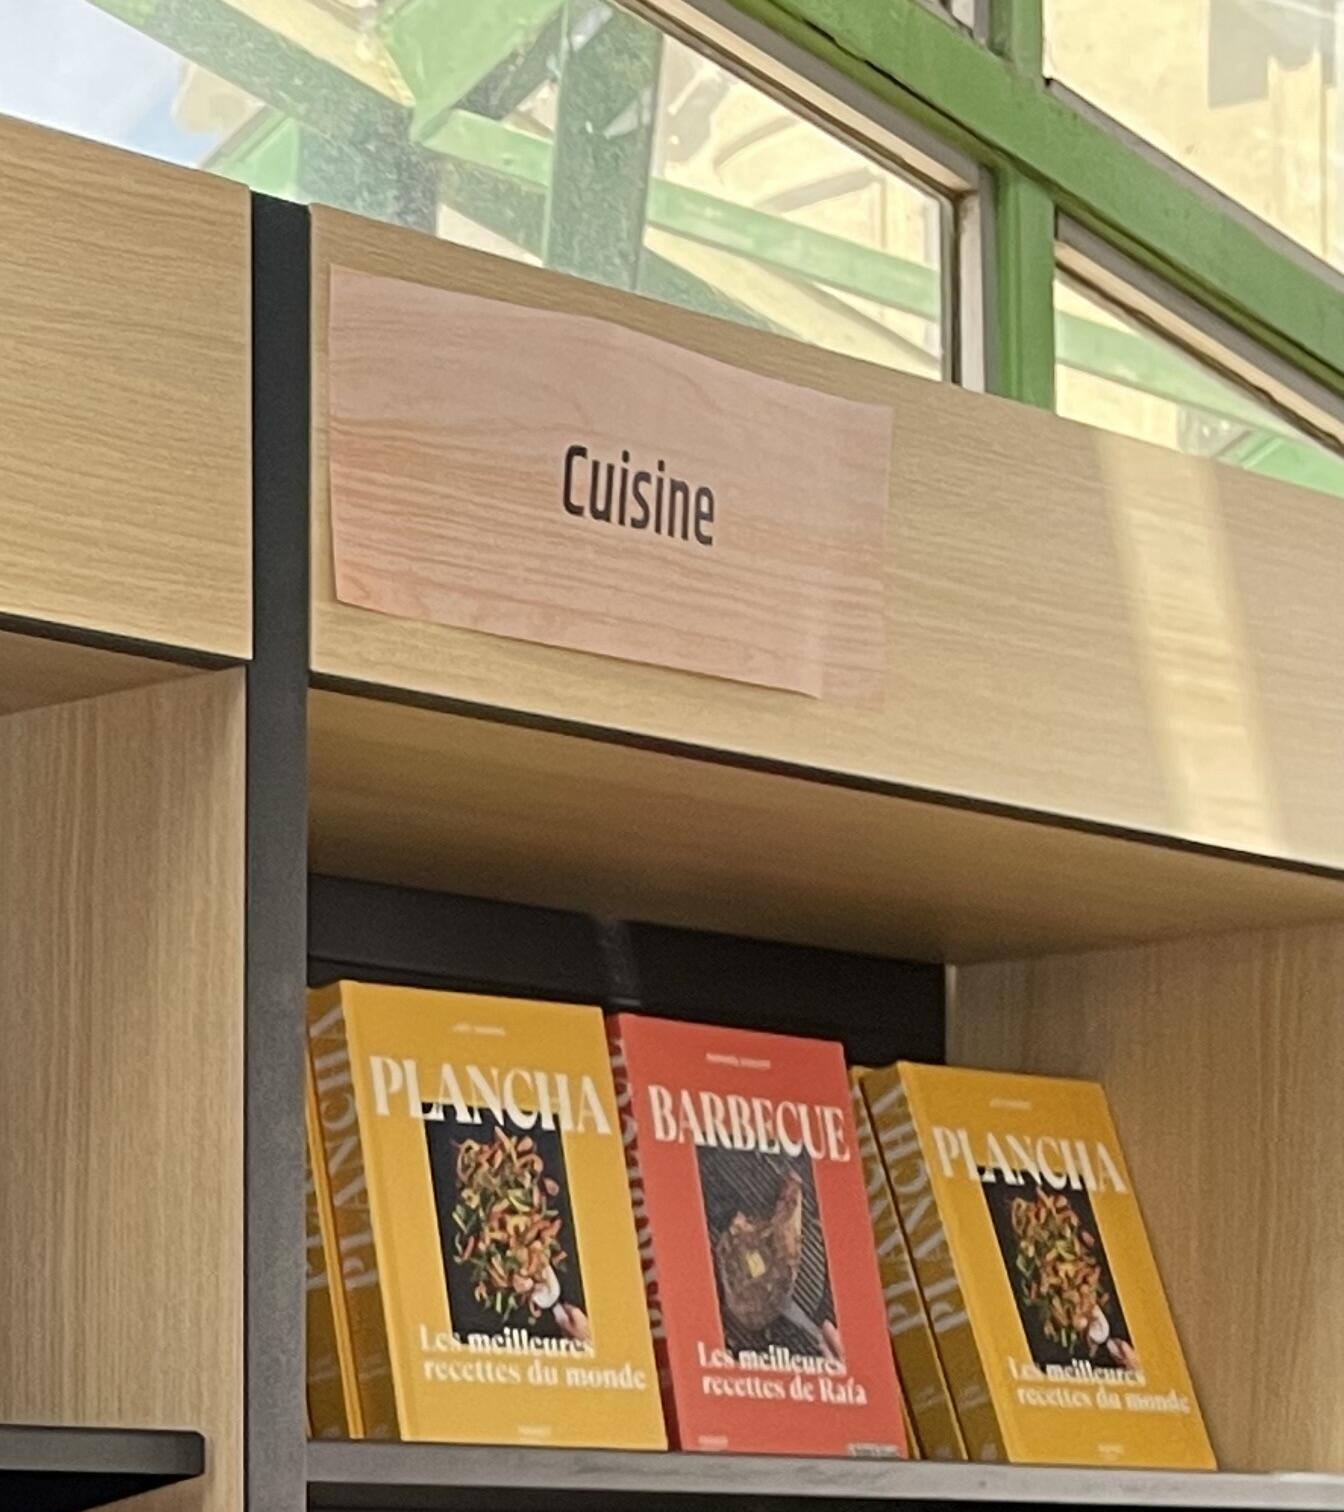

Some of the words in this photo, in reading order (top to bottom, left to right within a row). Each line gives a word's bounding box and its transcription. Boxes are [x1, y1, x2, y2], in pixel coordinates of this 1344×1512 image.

[563, 444, 715, 546] Cuisine
[368, 1054, 613, 1137] PLANCHA
[647, 1084, 851, 1163] BARBECUE
[309, 1004, 378, 1291] PLANCHA
[930, 1124, 1130, 1195] PLANCHA
[419, 1324, 463, 1351] Les
[467, 1327, 595, 1359] meilleures
[696, 1340, 735, 1369] Les
[738, 1344, 848, 1378] meilleures
[423, 1359, 521, 1384] recettes
[527, 1359, 559, 1386] du
[565, 1363, 646, 1391] monde
[702, 1375, 787, 1400] recettes
[789, 1374, 814, 1402] de
[818, 1376, 869, 1405] Rafa
[1047, 1358, 1147, 1388] meilleures
[1016, 1387, 1094, 1409] recettes
[1095, 1384, 1123, 1411] du
[1124, 1389, 1192, 1415] monde
